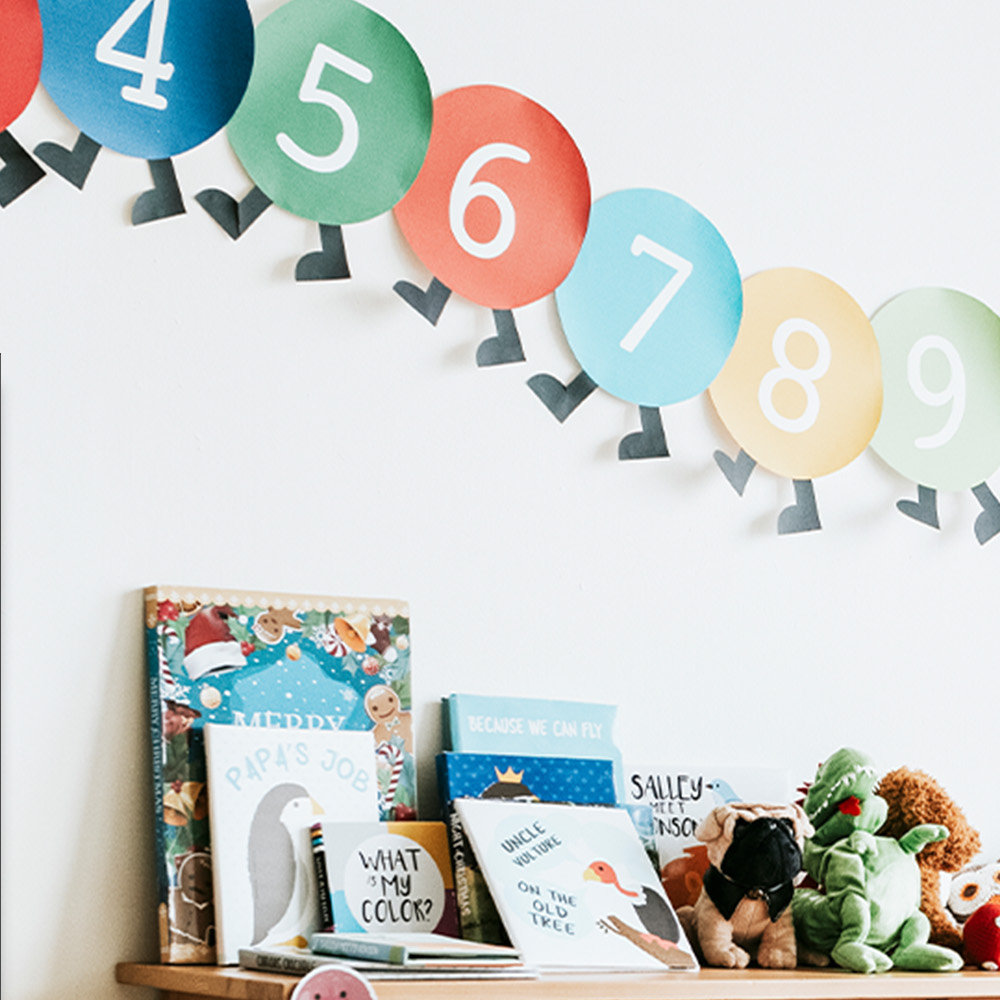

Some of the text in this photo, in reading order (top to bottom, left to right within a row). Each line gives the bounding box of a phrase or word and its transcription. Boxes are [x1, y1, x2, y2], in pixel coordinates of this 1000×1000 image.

[95, 0, 175, 111] 4
[275, 42, 373, 173] 5
[449, 142, 531, 259] 6
[619, 233, 693, 353] 7
[758, 317, 832, 433] 8
[907, 334, 966, 449] 9
[467, 715, 602, 739] BECAUSE WE CAN FLY
[225, 742, 369, 792] PAPA'S JOB
[631, 774, 702, 801] SALLEY
[500, 821, 546, 854] UNCLE
[512, 834, 562, 868] VULTURE
[359, 849, 421, 871] WHAT
[518, 880, 577, 907] ON THE
[362, 899, 432, 923] COLOR?
[532, 899, 567, 918] OLD
[528, 911, 575, 935] TREE
